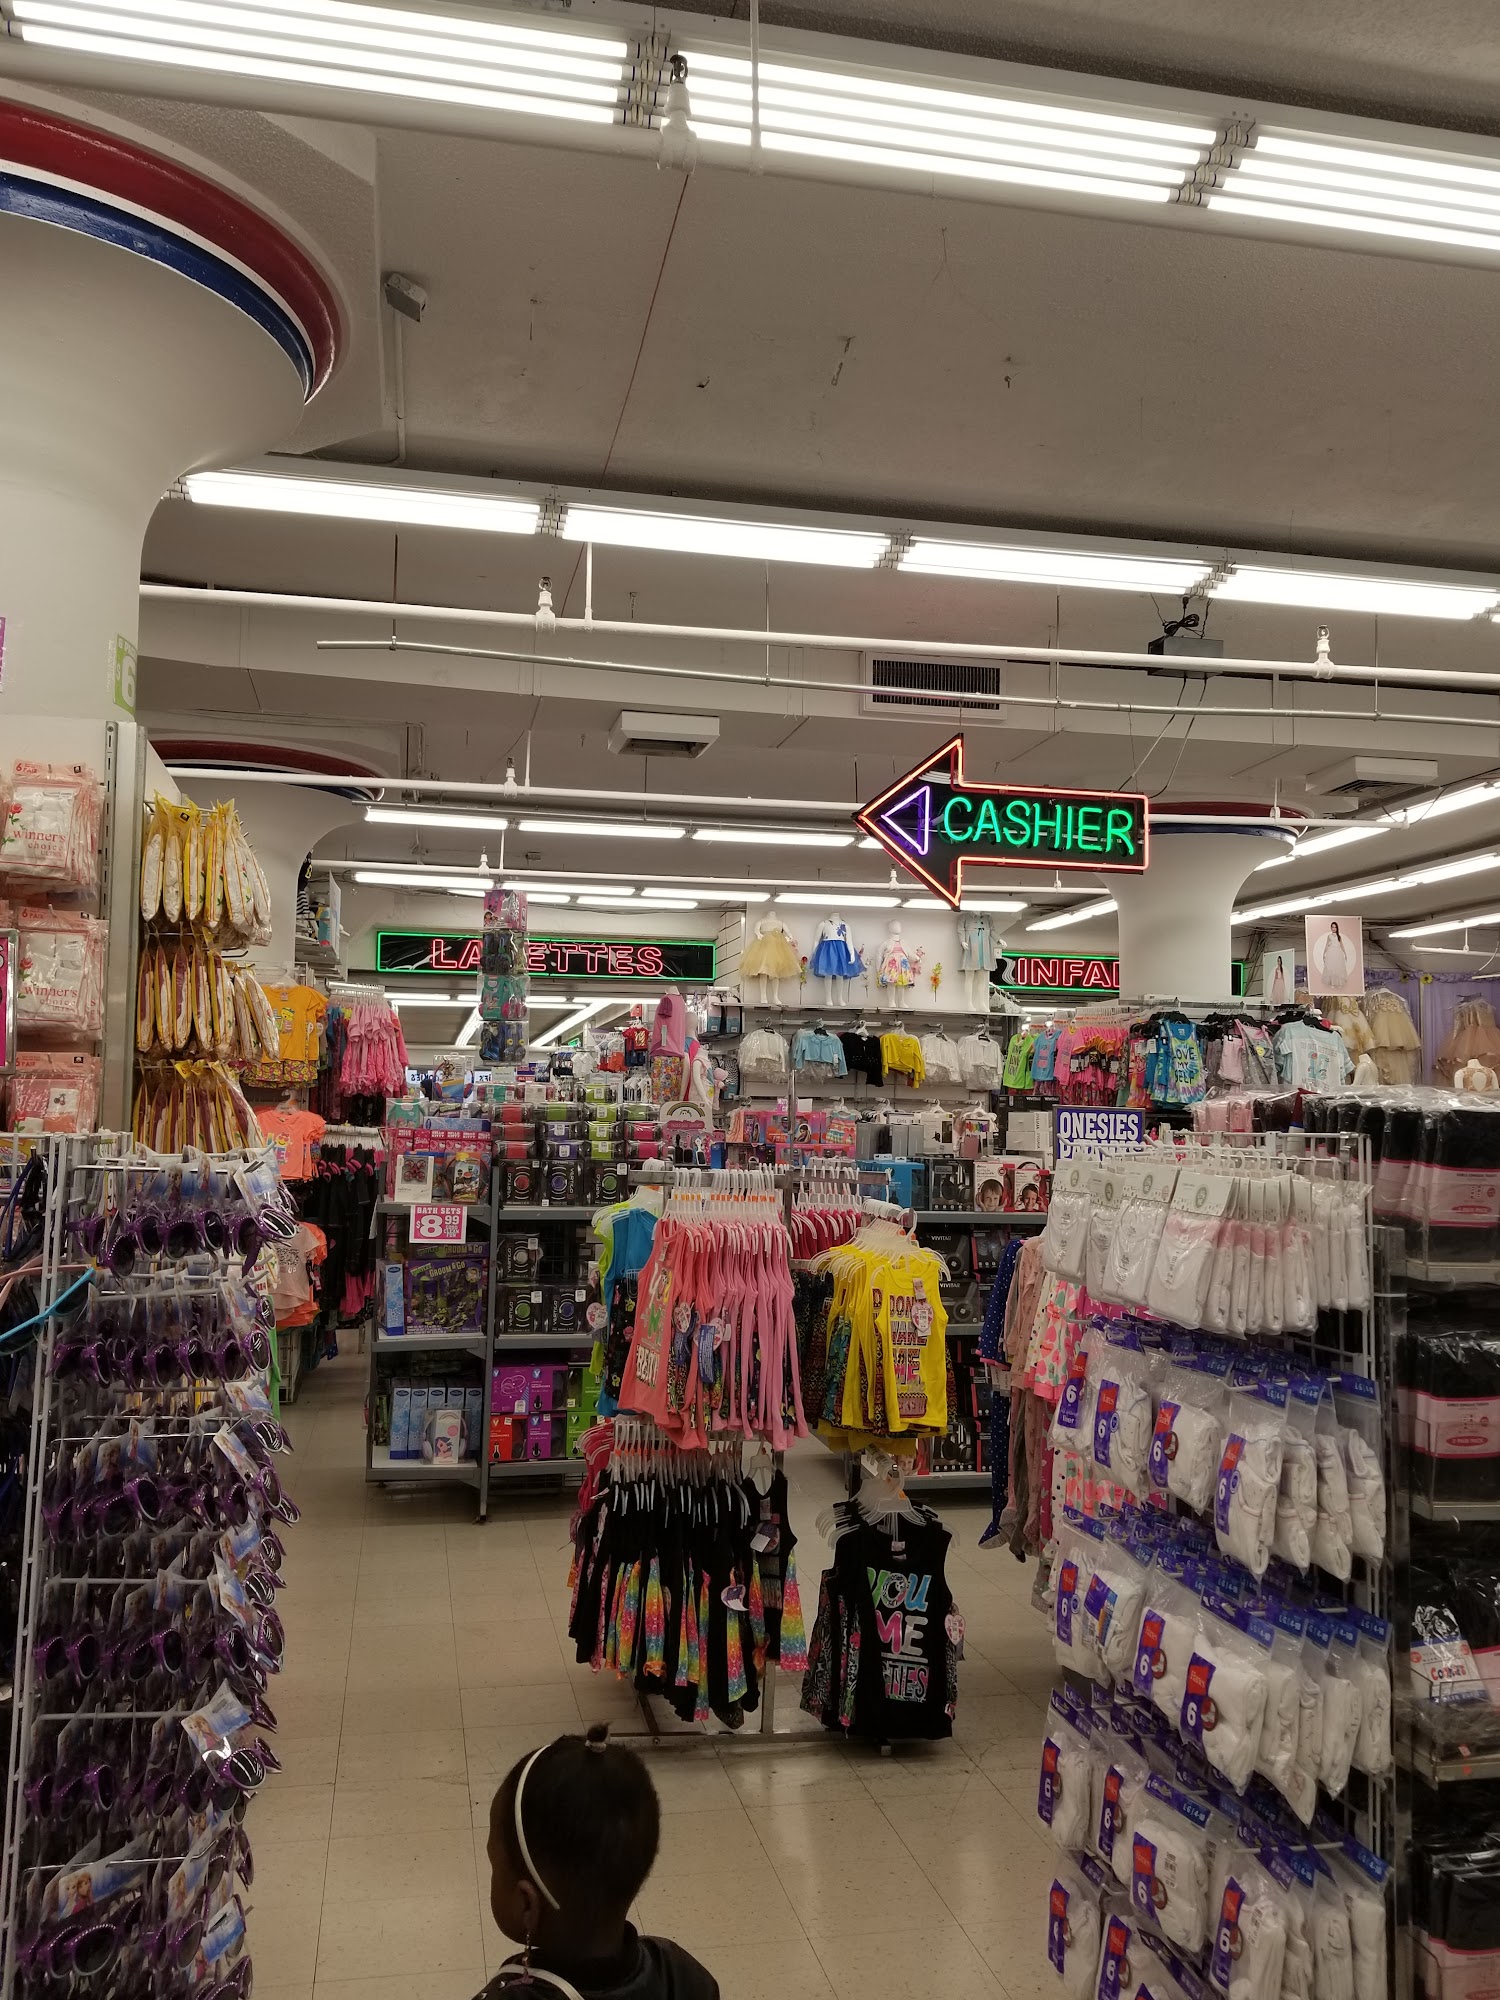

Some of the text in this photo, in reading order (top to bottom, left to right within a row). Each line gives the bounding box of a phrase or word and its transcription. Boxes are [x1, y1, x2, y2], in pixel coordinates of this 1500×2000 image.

[16, 762, 22, 772] 6
[14, 830, 66, 842] winner's
[943, 796, 1135, 856] CASHIER
[22, 908, 28, 918] 6
[432, 938, 664, 976] LAETTES
[24, 986, 78, 998] winner's
[1178, 1060, 1188, 1068] MY
[1060, 1112, 1138, 1140] ONESIES
[443, 1245, 467, 1253] GROOM
[473, 1245, 482, 1253] GO
[429, 1266, 452, 1277] GROOM
[456, 1261, 466, 1269] GO
[1066, 1384, 1077, 1404] 6
[1098, 1418, 1106, 1439] 6
[1153, 1440, 1162, 1462] 6
[1219, 1477, 1227, 1500] 6
[867, 1566, 932, 1612] YOU
[1061, 1597, 1068, 1618] 6
[875, 1611, 928, 1656] ME
[1140, 1653, 1150, 1676] 6
[1186, 1702, 1198, 1727] 6
[1044, 1777, 1052, 1798] 6
[1104, 1807, 1112, 1830] 6
[1137, 1880, 1148, 1905] 6
[1219, 1927, 1231, 1954] 6
[1106, 1959, 1116, 1982] 6
